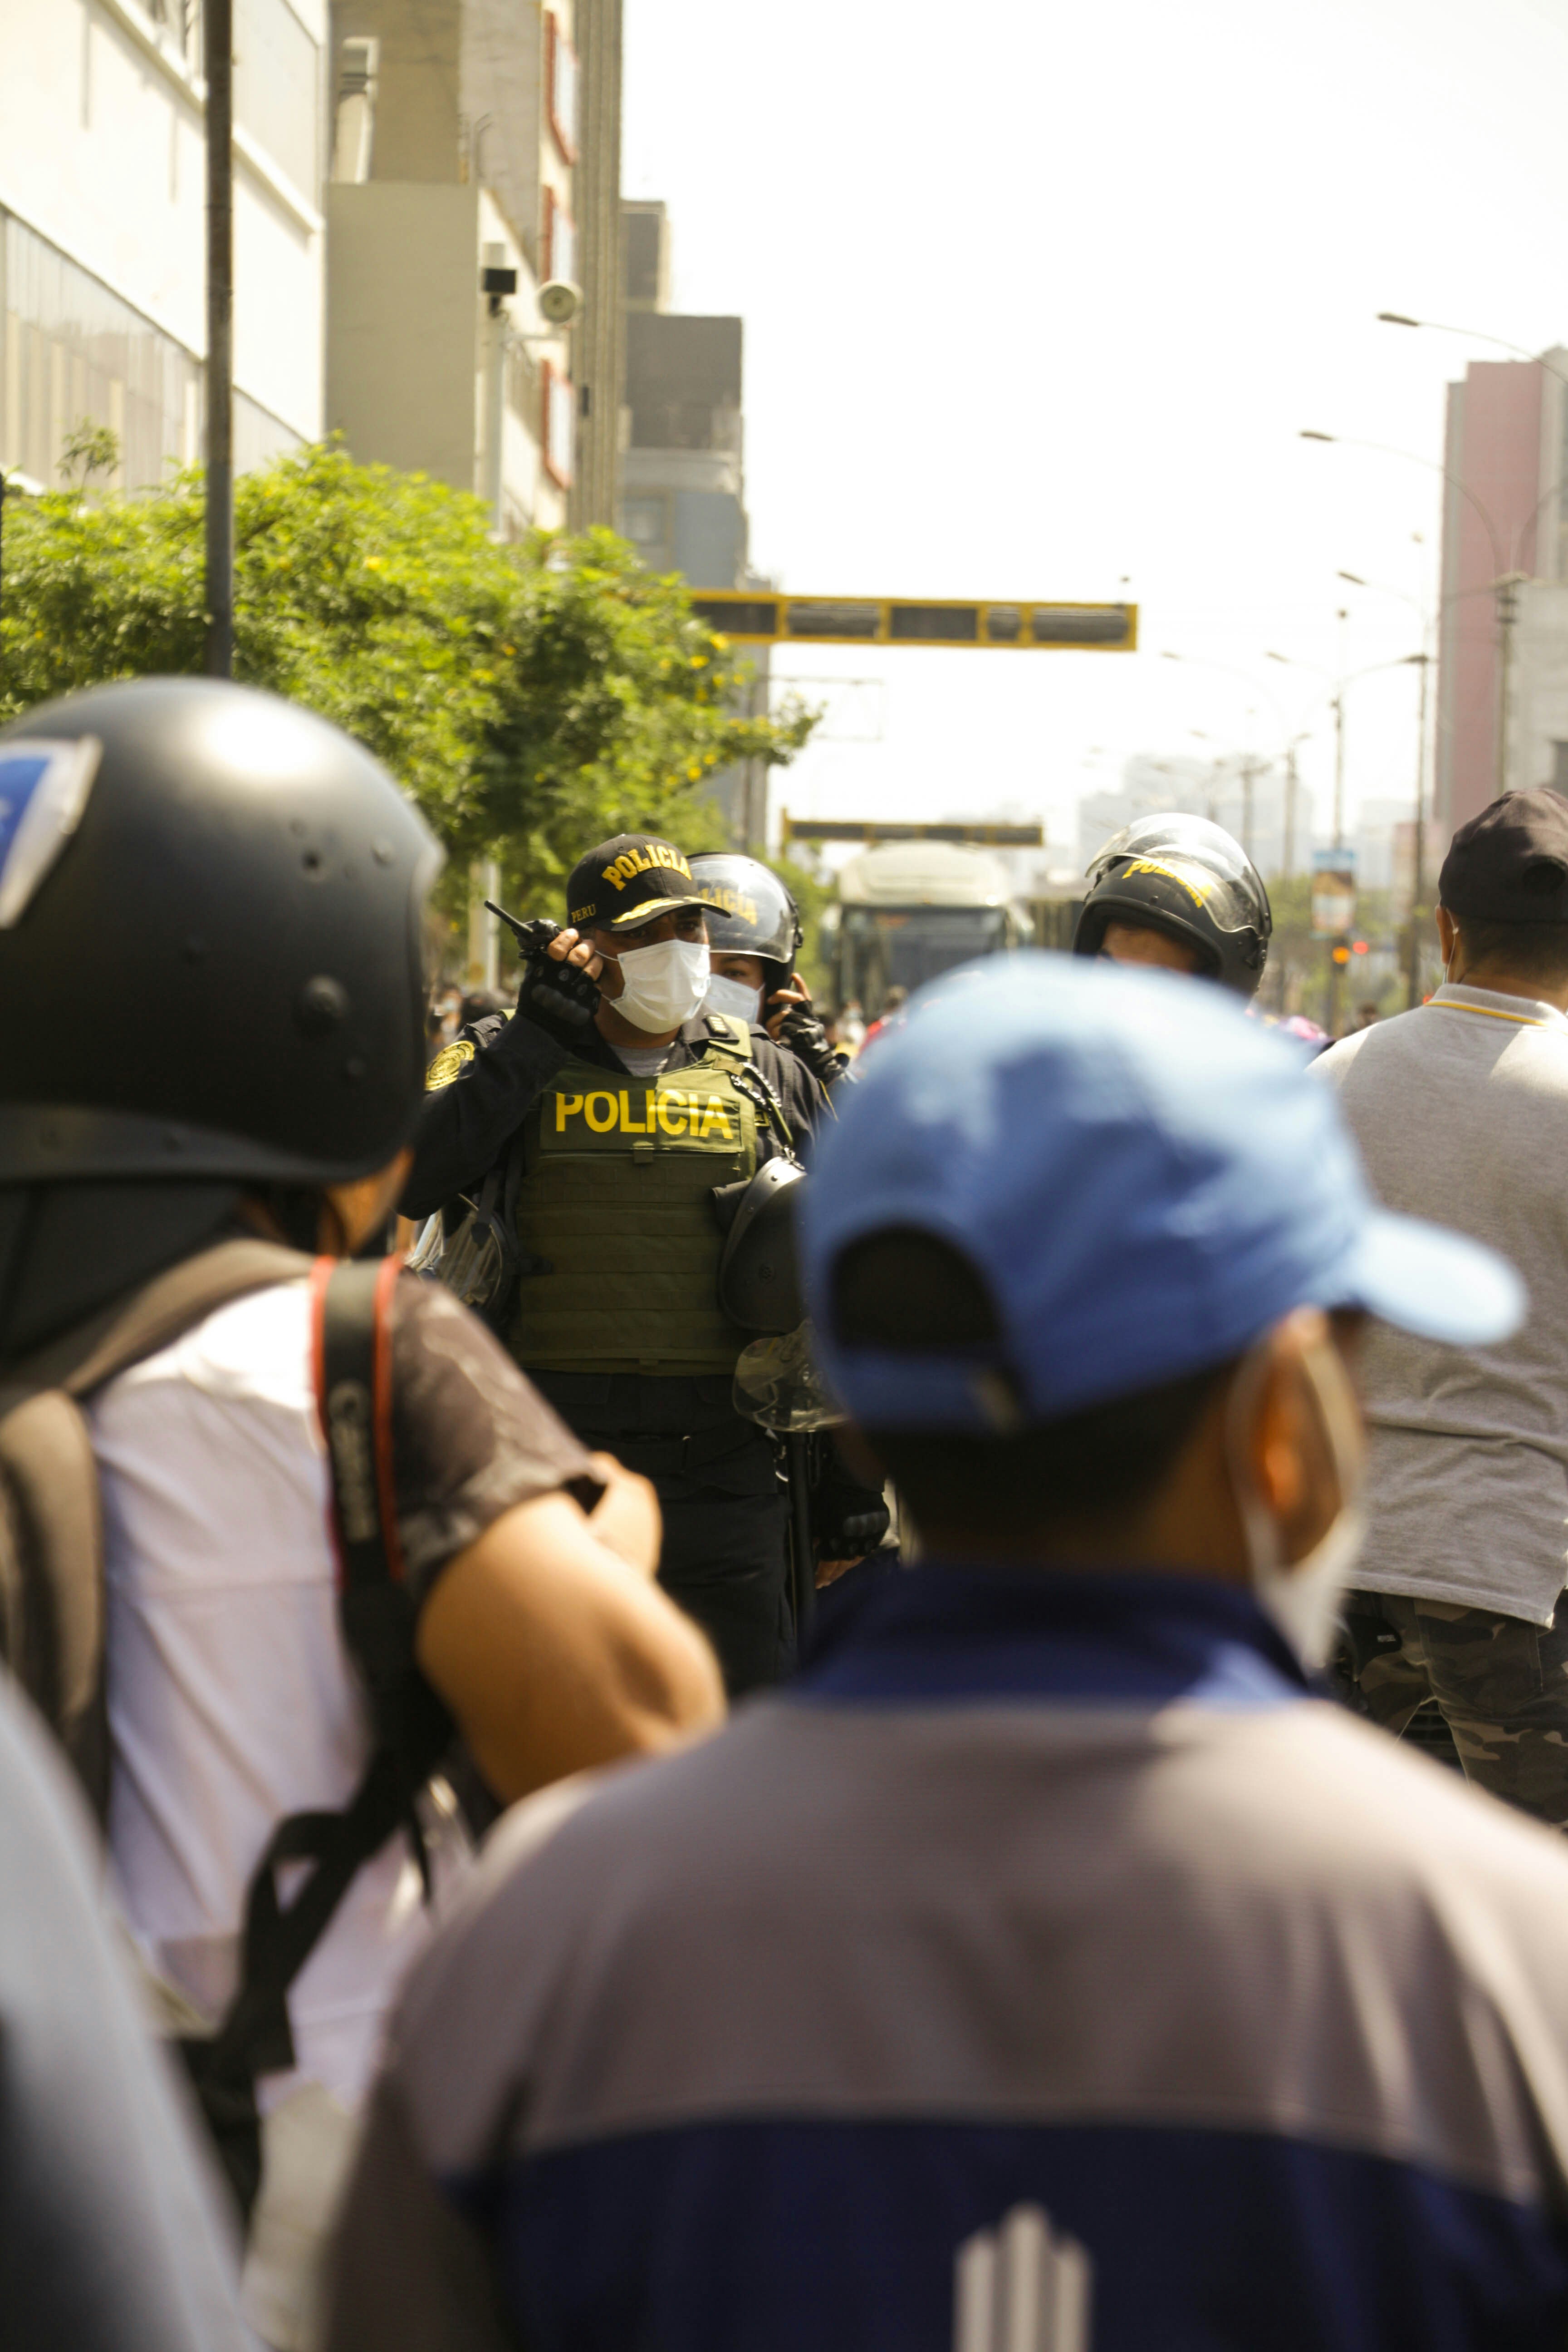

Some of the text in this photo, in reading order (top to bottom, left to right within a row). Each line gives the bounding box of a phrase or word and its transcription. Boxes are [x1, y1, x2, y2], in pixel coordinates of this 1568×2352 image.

[602, 844, 692, 891] POLICIA
[571, 903, 596, 923] PERU
[556, 1090, 733, 1139] POLICIA
